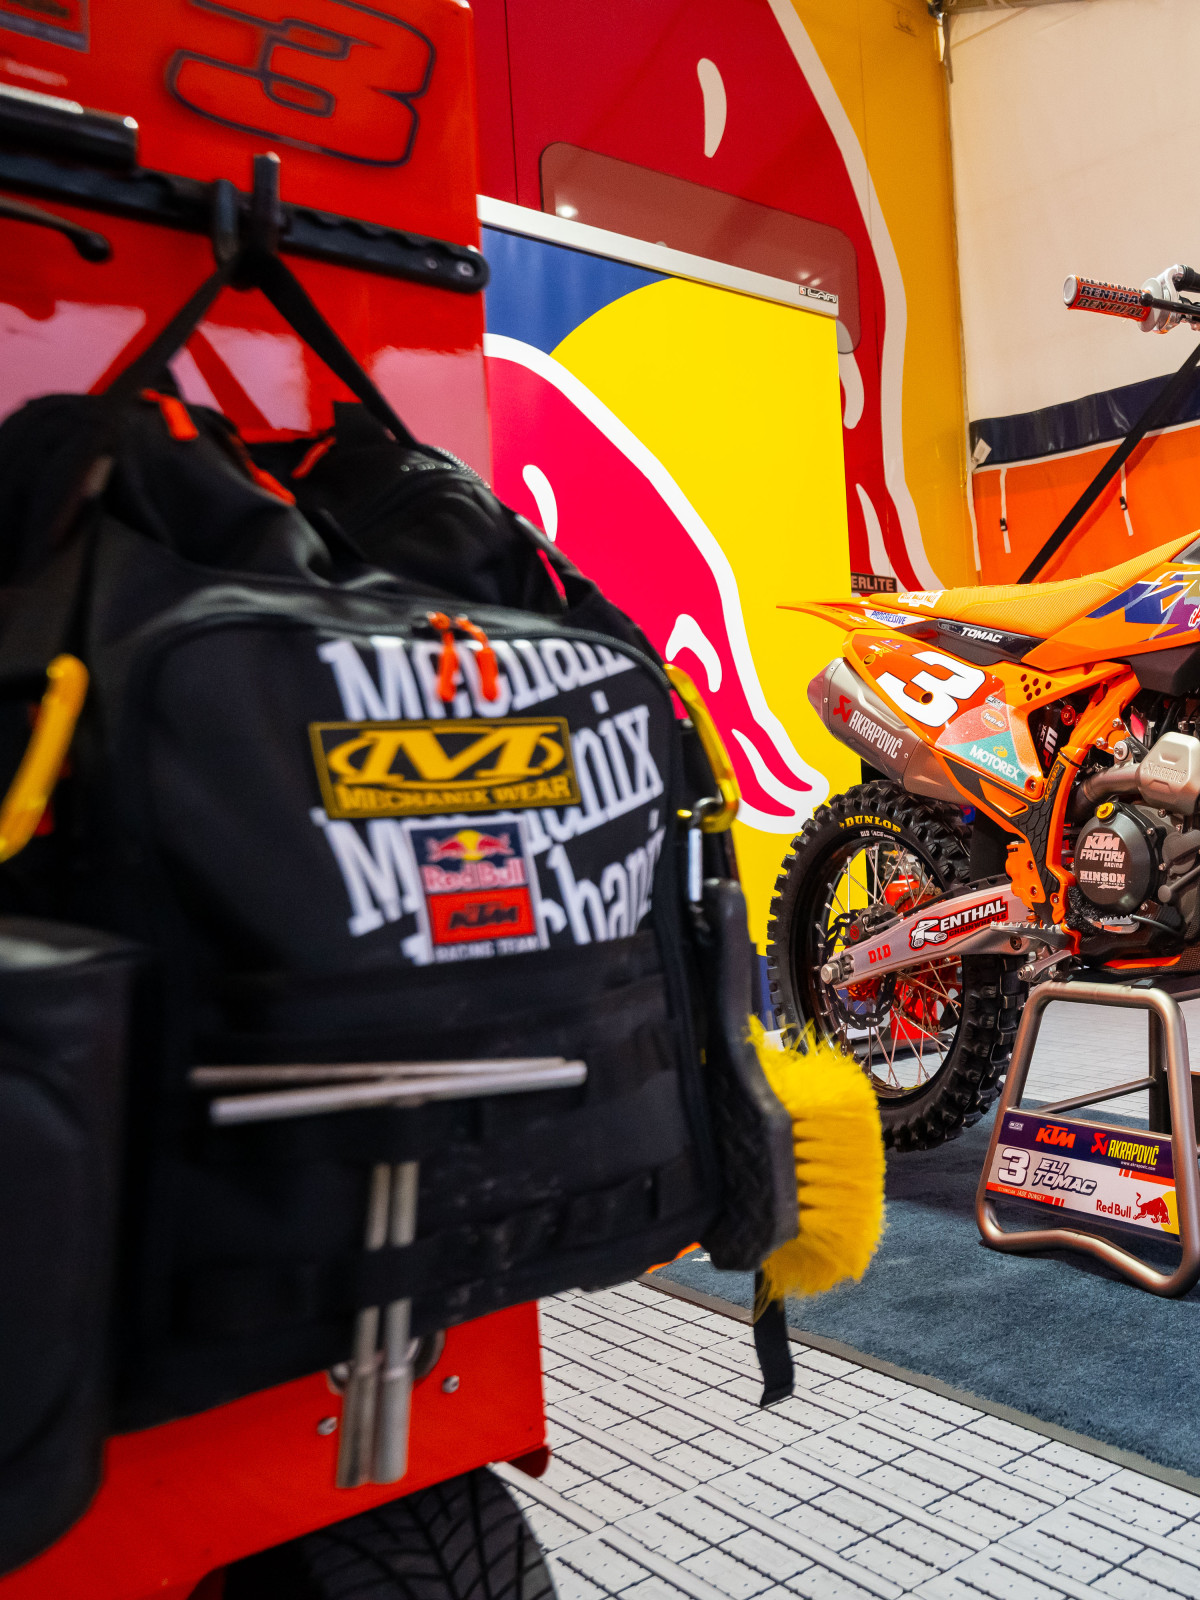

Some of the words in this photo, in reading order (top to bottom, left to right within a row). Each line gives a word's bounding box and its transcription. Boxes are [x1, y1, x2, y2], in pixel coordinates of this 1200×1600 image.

[165, 0, 436, 167] 3
[1080, 285, 1141, 304] RENTHA
[1077, 297, 1145, 317] RENTHAL
[871, 610, 908, 625] PROGRESSIVE
[961, 626, 1003, 643] TOMAC
[875, 650, 987, 728] 3
[969, 744, 1020, 782] MOTOREX
[335, 784, 491, 811] MECHANIX
[490, 779, 572, 803] WEAR
[844, 815, 902, 833] DUNLOP
[1084, 832, 1121, 851] KTM
[1079, 849, 1125, 863] FACTORY
[421, 862, 473, 892] Red
[474, 858, 525, 888] Bull
[1079, 870, 1126, 884] HINSON
[449, 901, 519, 930] KTM
[911, 900, 1006, 949] RENTHAL
[949, 913, 1007, 936] CHAINWHEELS
[867, 944, 892, 964] DID
[1035, 1124, 1077, 1149] KTM
[998, 1146, 1031, 1187] 3
[1038, 1157, 1070, 1175] ELI
[1031, 1169, 1098, 1197] TOMAC
[1096, 1199, 1114, 1214] Red
[1114, 1203, 1132, 1219] Bull
